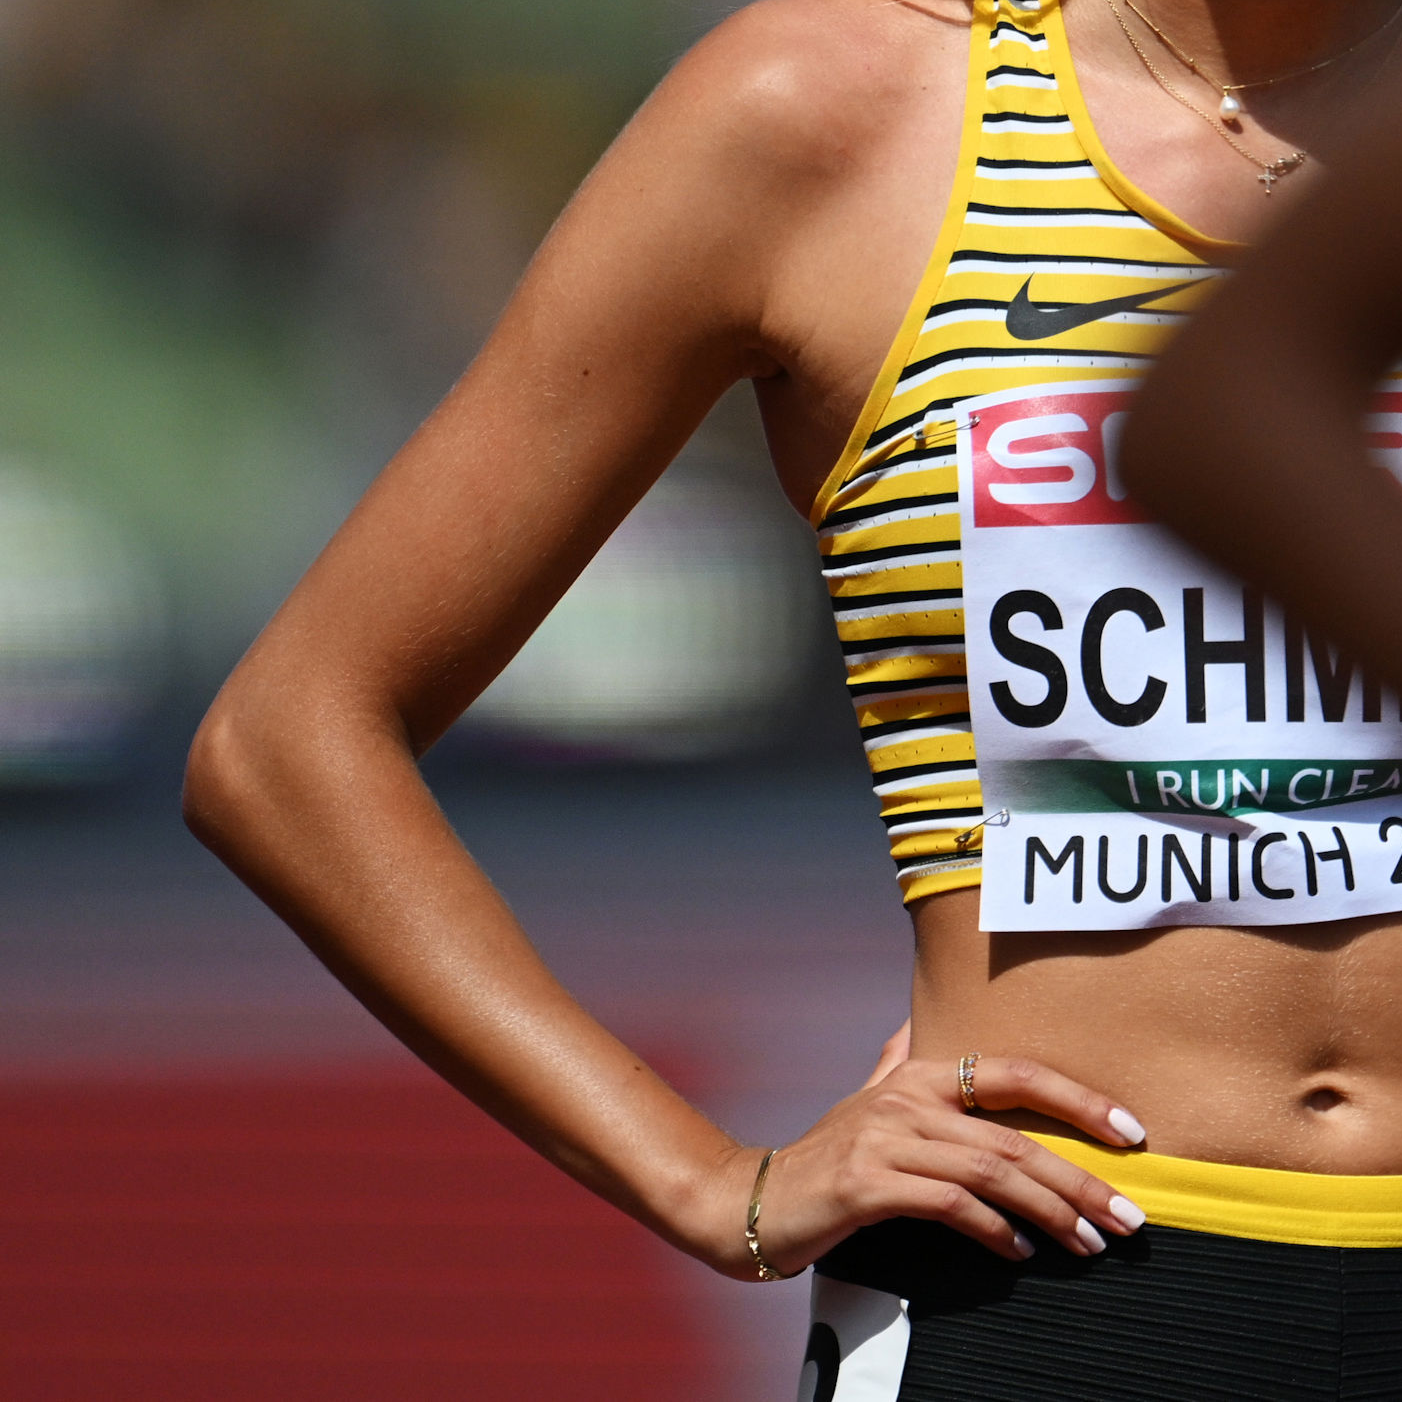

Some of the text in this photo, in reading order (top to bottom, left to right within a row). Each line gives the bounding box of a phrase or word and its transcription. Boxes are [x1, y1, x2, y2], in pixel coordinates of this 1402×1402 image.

[1126, 770, 1140, 804] I
[1156, 768, 1269, 811] RUN
[1023, 826, 1355, 905] MUNICH
